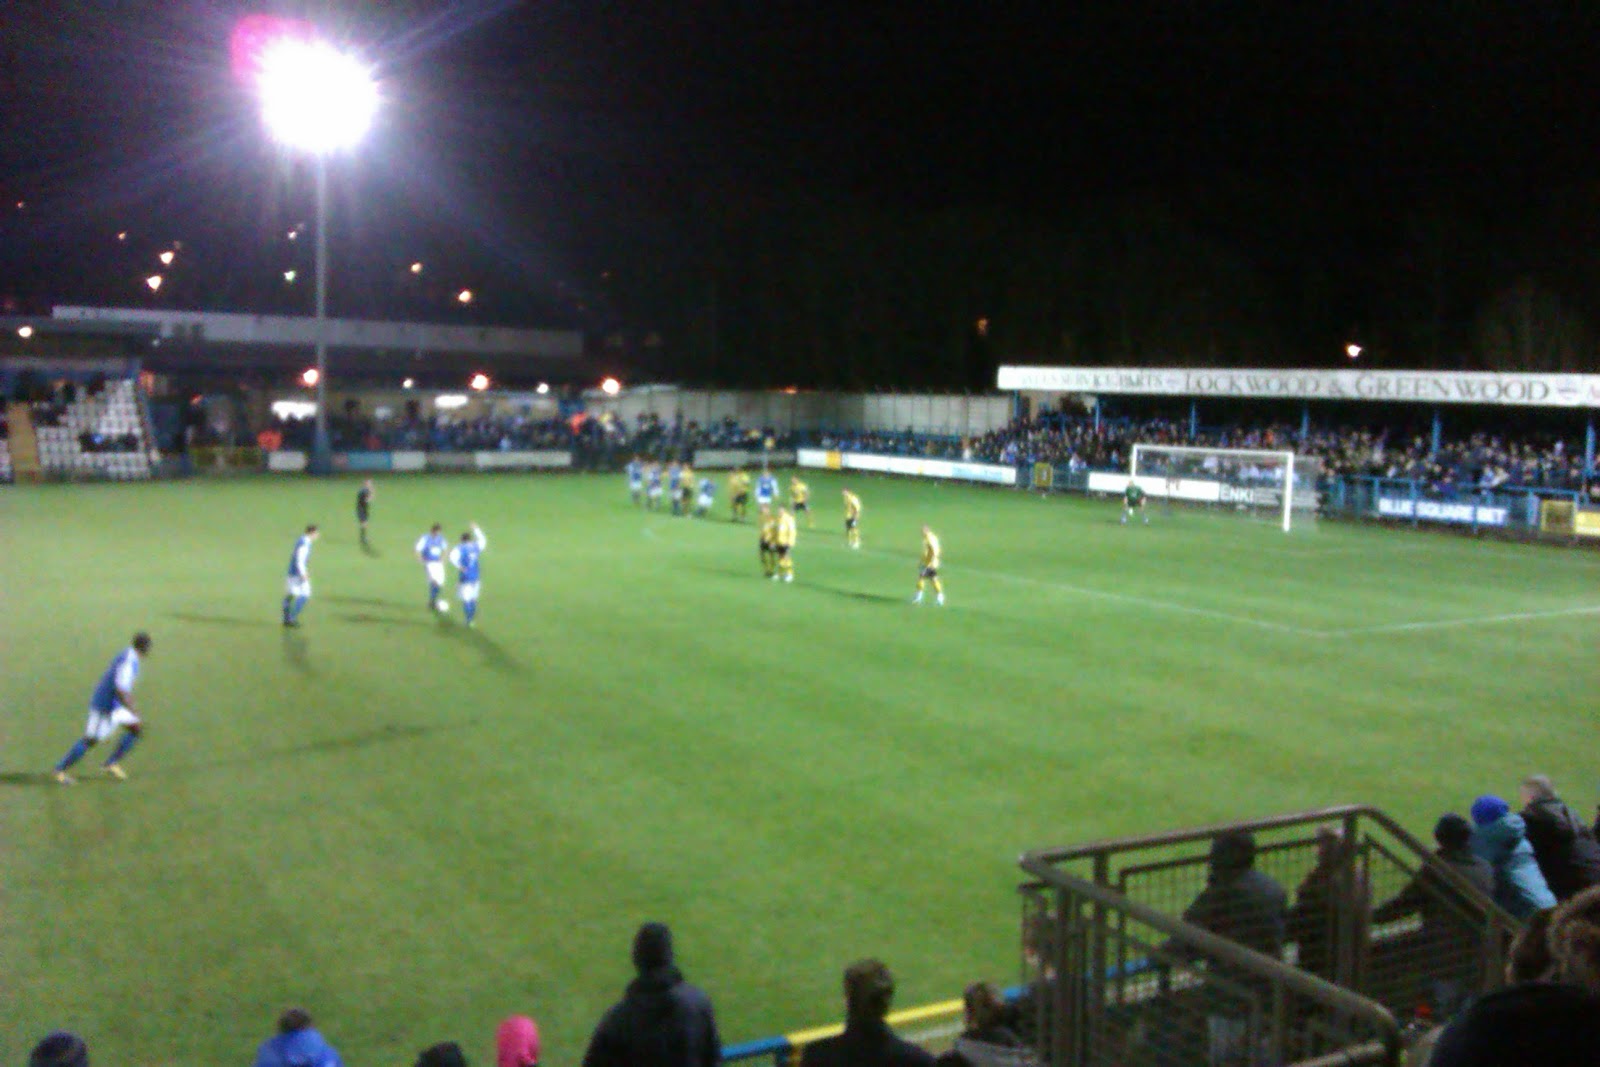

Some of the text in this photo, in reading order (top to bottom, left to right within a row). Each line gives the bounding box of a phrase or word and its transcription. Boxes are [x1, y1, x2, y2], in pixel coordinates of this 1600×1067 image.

[1184, 372, 1550, 402] LOCKWOOD & GREENWOOD
